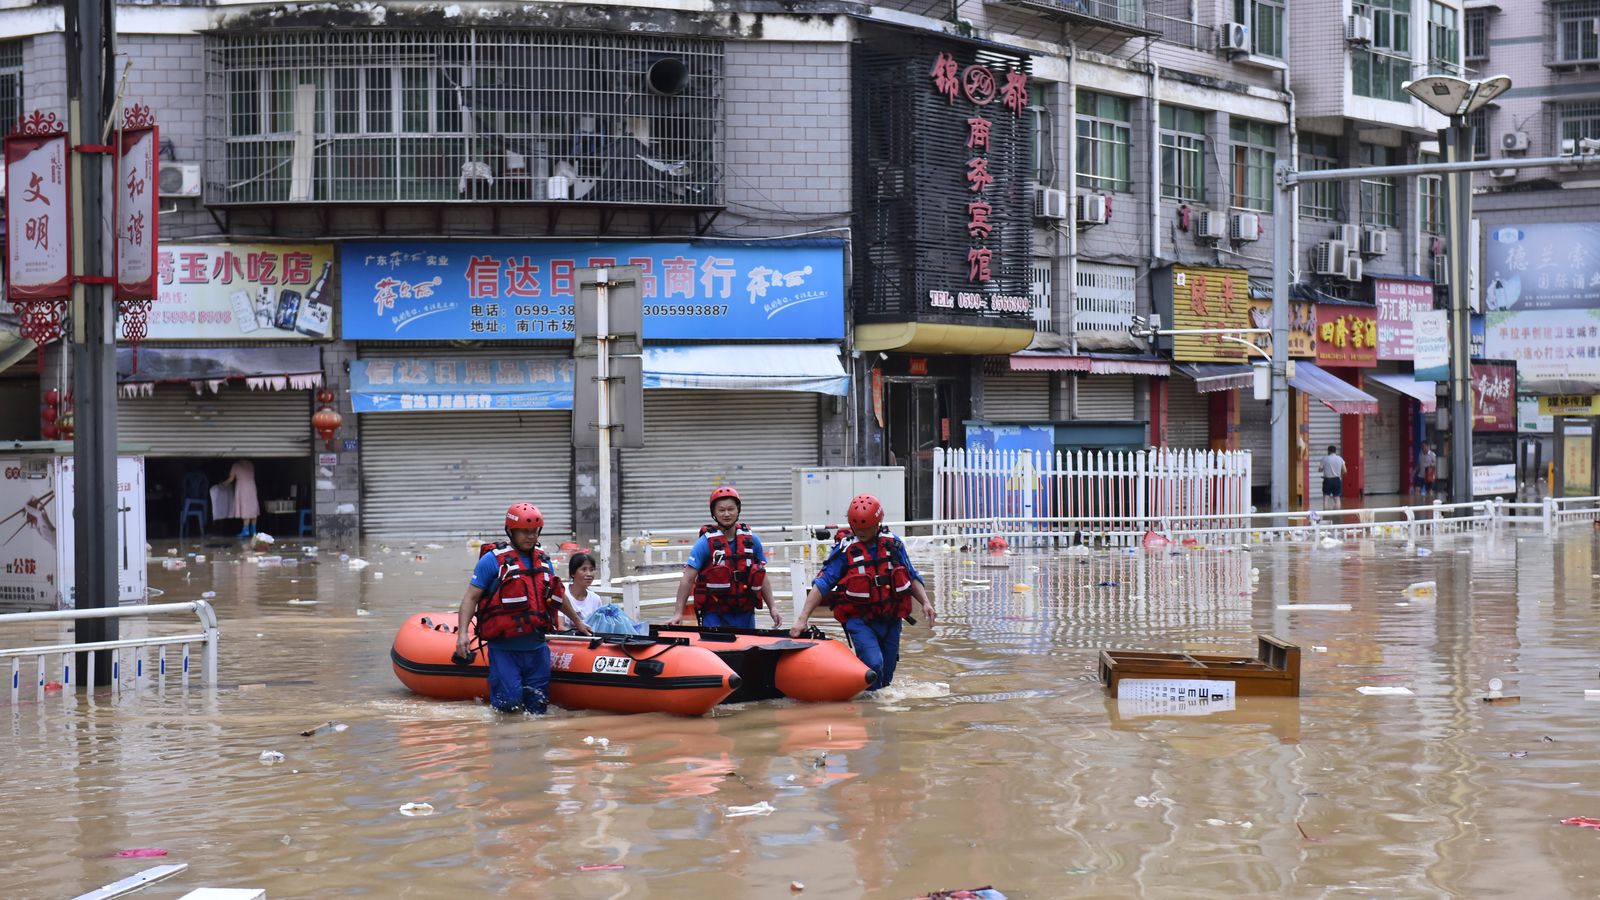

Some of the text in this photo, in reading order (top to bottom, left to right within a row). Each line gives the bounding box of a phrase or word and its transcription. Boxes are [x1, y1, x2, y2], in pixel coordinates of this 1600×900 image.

[1000, 66, 1028, 118] 都
[23, 171, 50, 250] 文明
[127, 166, 144, 247] 和谐
[966, 116, 993, 282] 商务宾馆
[465, 255, 736, 299] 信达日品商行
[930, 290, 954, 308] TEL:
[516, 319, 575, 333] 南门市场
[1514, 346, 1600, 359] 心连心打造文明建
